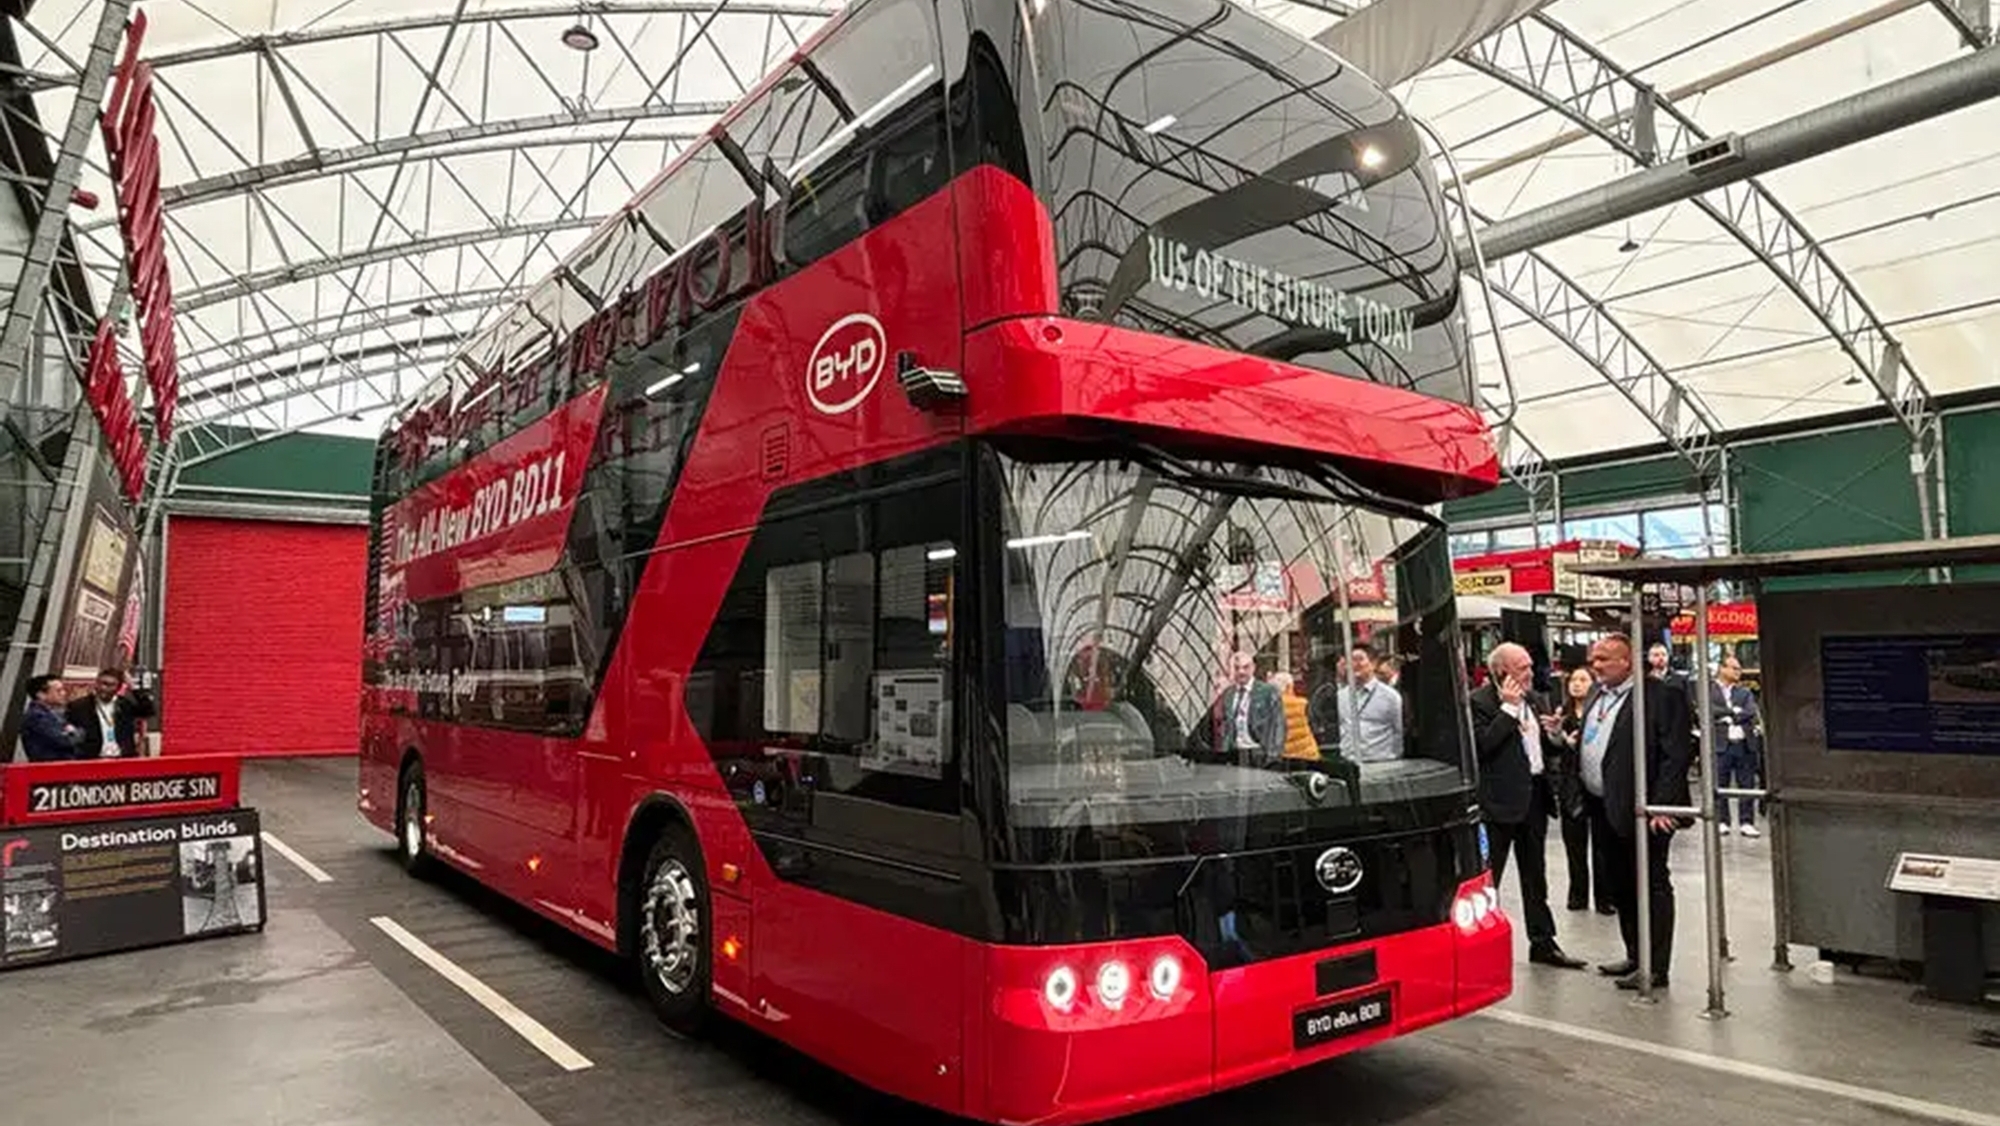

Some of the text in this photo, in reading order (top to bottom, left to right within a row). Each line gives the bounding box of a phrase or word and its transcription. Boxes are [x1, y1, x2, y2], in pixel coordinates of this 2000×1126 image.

[1194, 247, 1224, 299] OF
[1227, 258, 1268, 312] THE
[1274, 271, 1352, 342] FUTURE,
[1355, 295, 1415, 352] TODAY
[815, 338, 876, 391] BYD
[471, 478, 507, 540] BYD
[508, 451, 565, 525] BD11
[34, 777, 217, 812] 21 LONDON BRIDGE STN
[61, 820, 238, 850] Destination blinds
[1307, 1014, 1332, 1036] BYD
